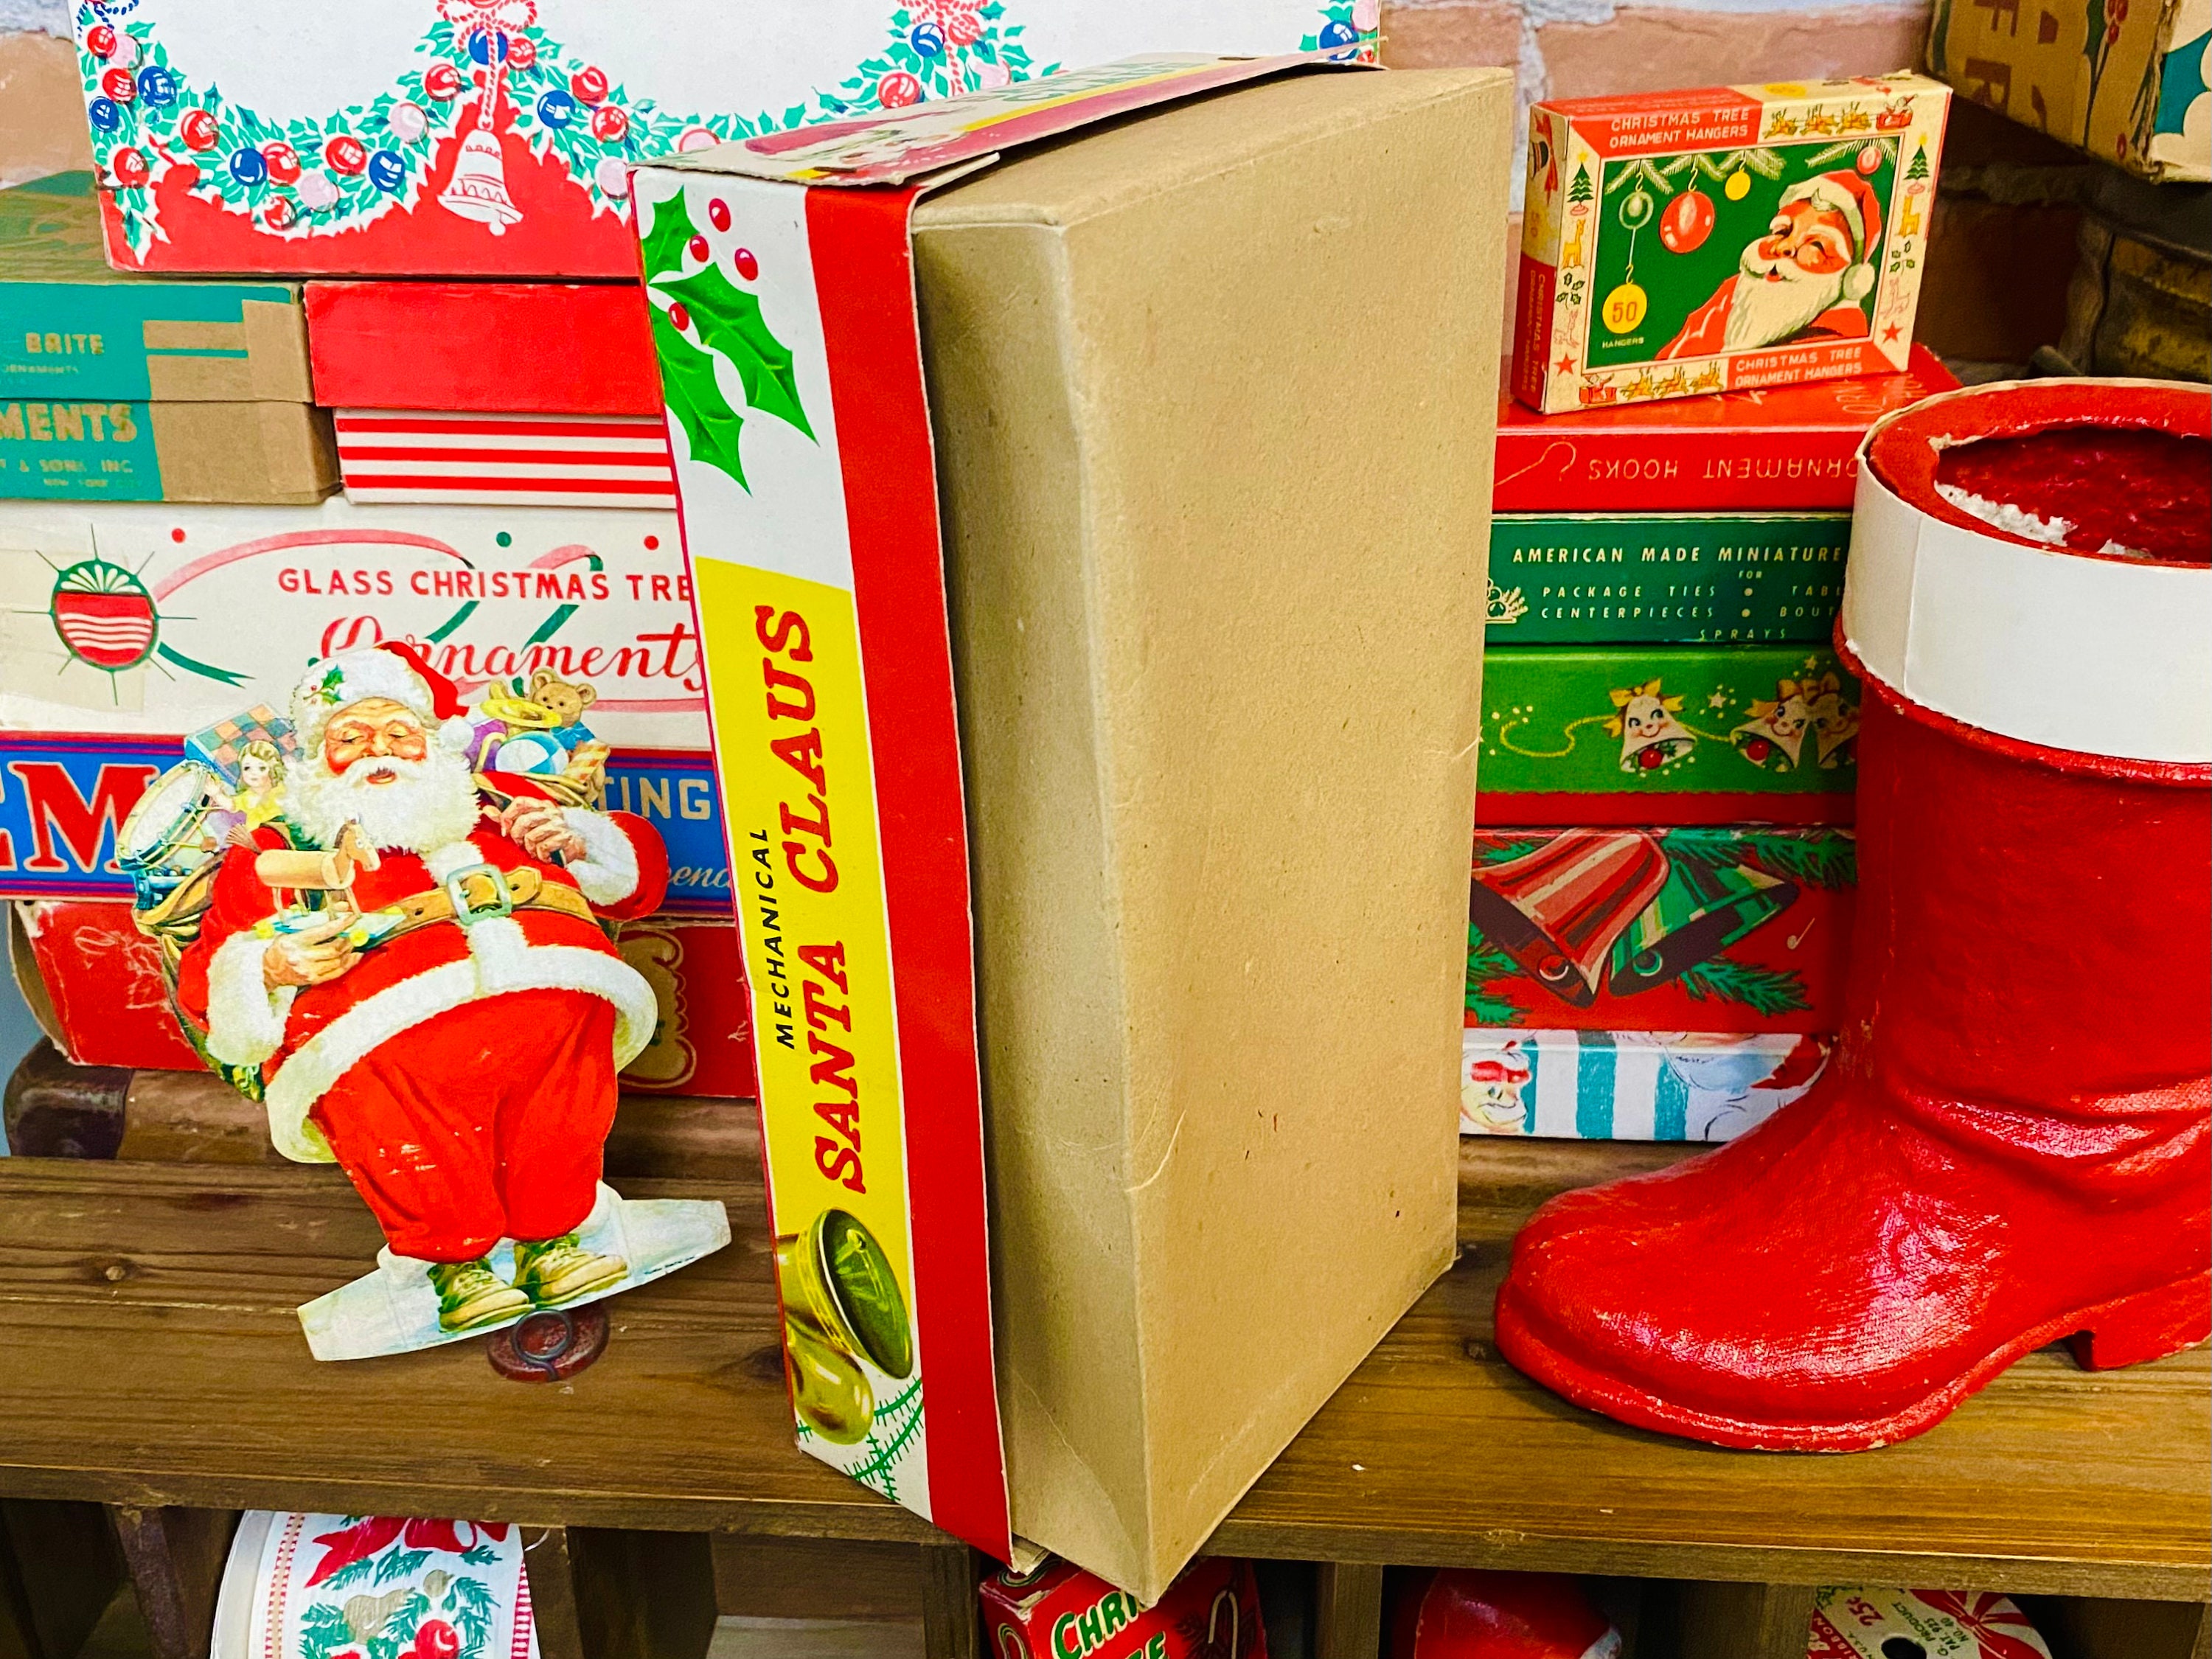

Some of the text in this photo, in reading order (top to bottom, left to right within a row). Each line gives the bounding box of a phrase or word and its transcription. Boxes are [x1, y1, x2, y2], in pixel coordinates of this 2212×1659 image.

[1610, 108, 1750, 132] CHRISTMAS TREE
[1609, 125, 1748, 149] ORNAMENT HANGERS
[1533, 274, 1546, 352] CHRISTMAS
[1612, 301, 1638, 324] 50
[25, 332, 104, 355] BRITE
[1601, 336, 1644, 349] HANGERS
[1736, 346, 1863, 372] CHRISTMAS TREE
[1734, 362, 1863, 388] ORNAMENT HANGERS
[0, 403, 138, 442] MENTS
[1587, 457, 1858, 481] ORNAMENT HOOKS
[1513, 546, 1841, 563] AMERICAN MADE MINIATURE
[278, 568, 394, 595] GLASS
[410, 570, 610, 600] CHRISTMAS
[1739, 570, 1763, 580] FOR
[1543, 585, 1643, 599] PACKAGE
[1669, 585, 1716, 598] TIES
[1541, 607, 1714, 619] CENTERPIECES
[1700, 627, 1786, 641] SPRAYS
[321, 615, 703, 692] Ornament
[754, 605, 866, 1194] SANTA CLAUS
[749, 828, 795, 1051] MECHANICAL
[1051, 1590, 1147, 1659] CHRI
[1891, 1601, 1936, 1642] PRODUCT
